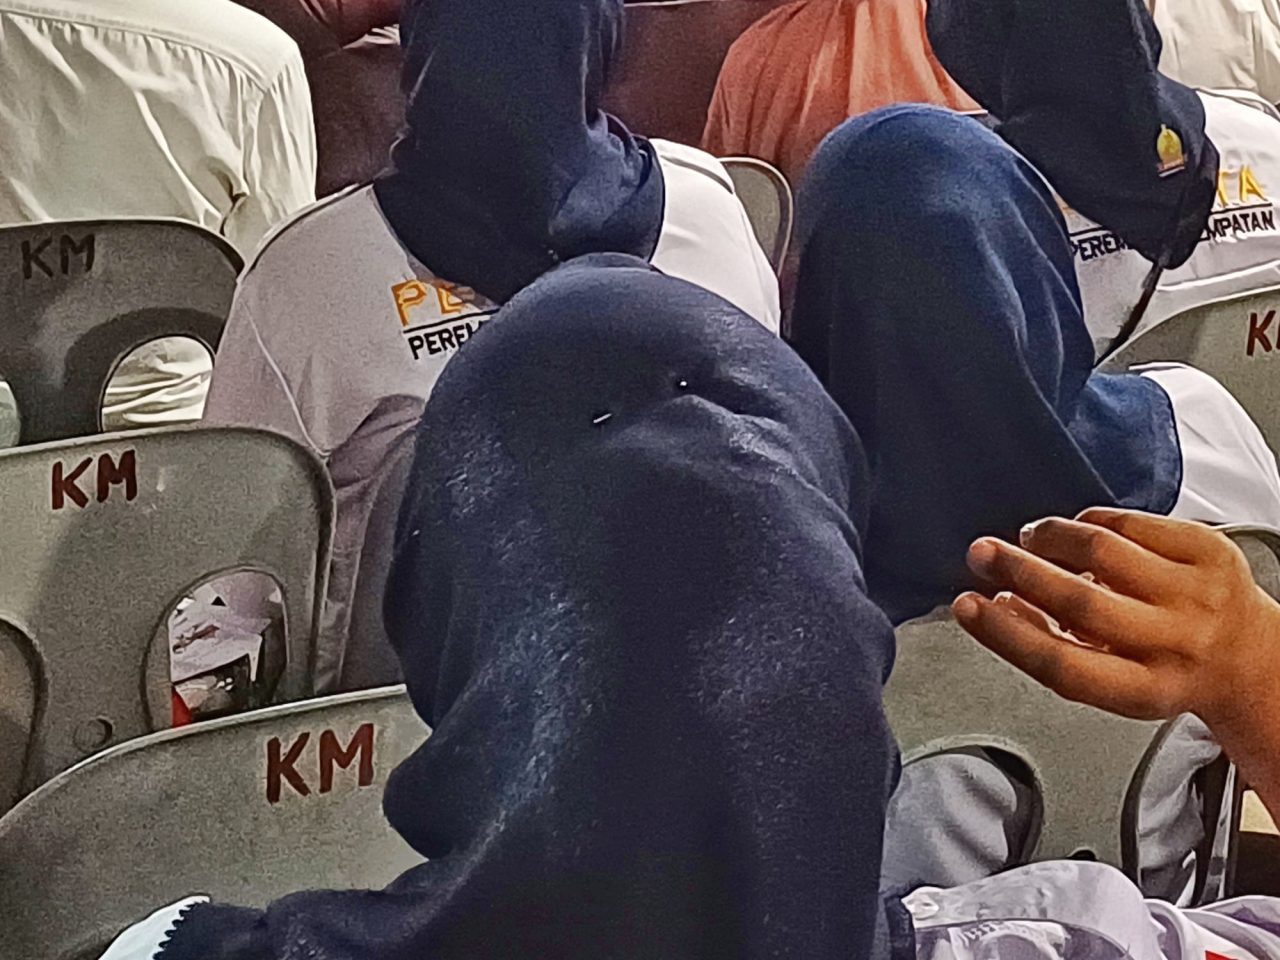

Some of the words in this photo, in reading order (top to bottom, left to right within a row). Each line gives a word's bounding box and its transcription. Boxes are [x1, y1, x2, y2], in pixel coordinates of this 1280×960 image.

[21, 234, 95, 279] KM
[51, 449, 138, 510] KM
[266, 723, 375, 805] KM
